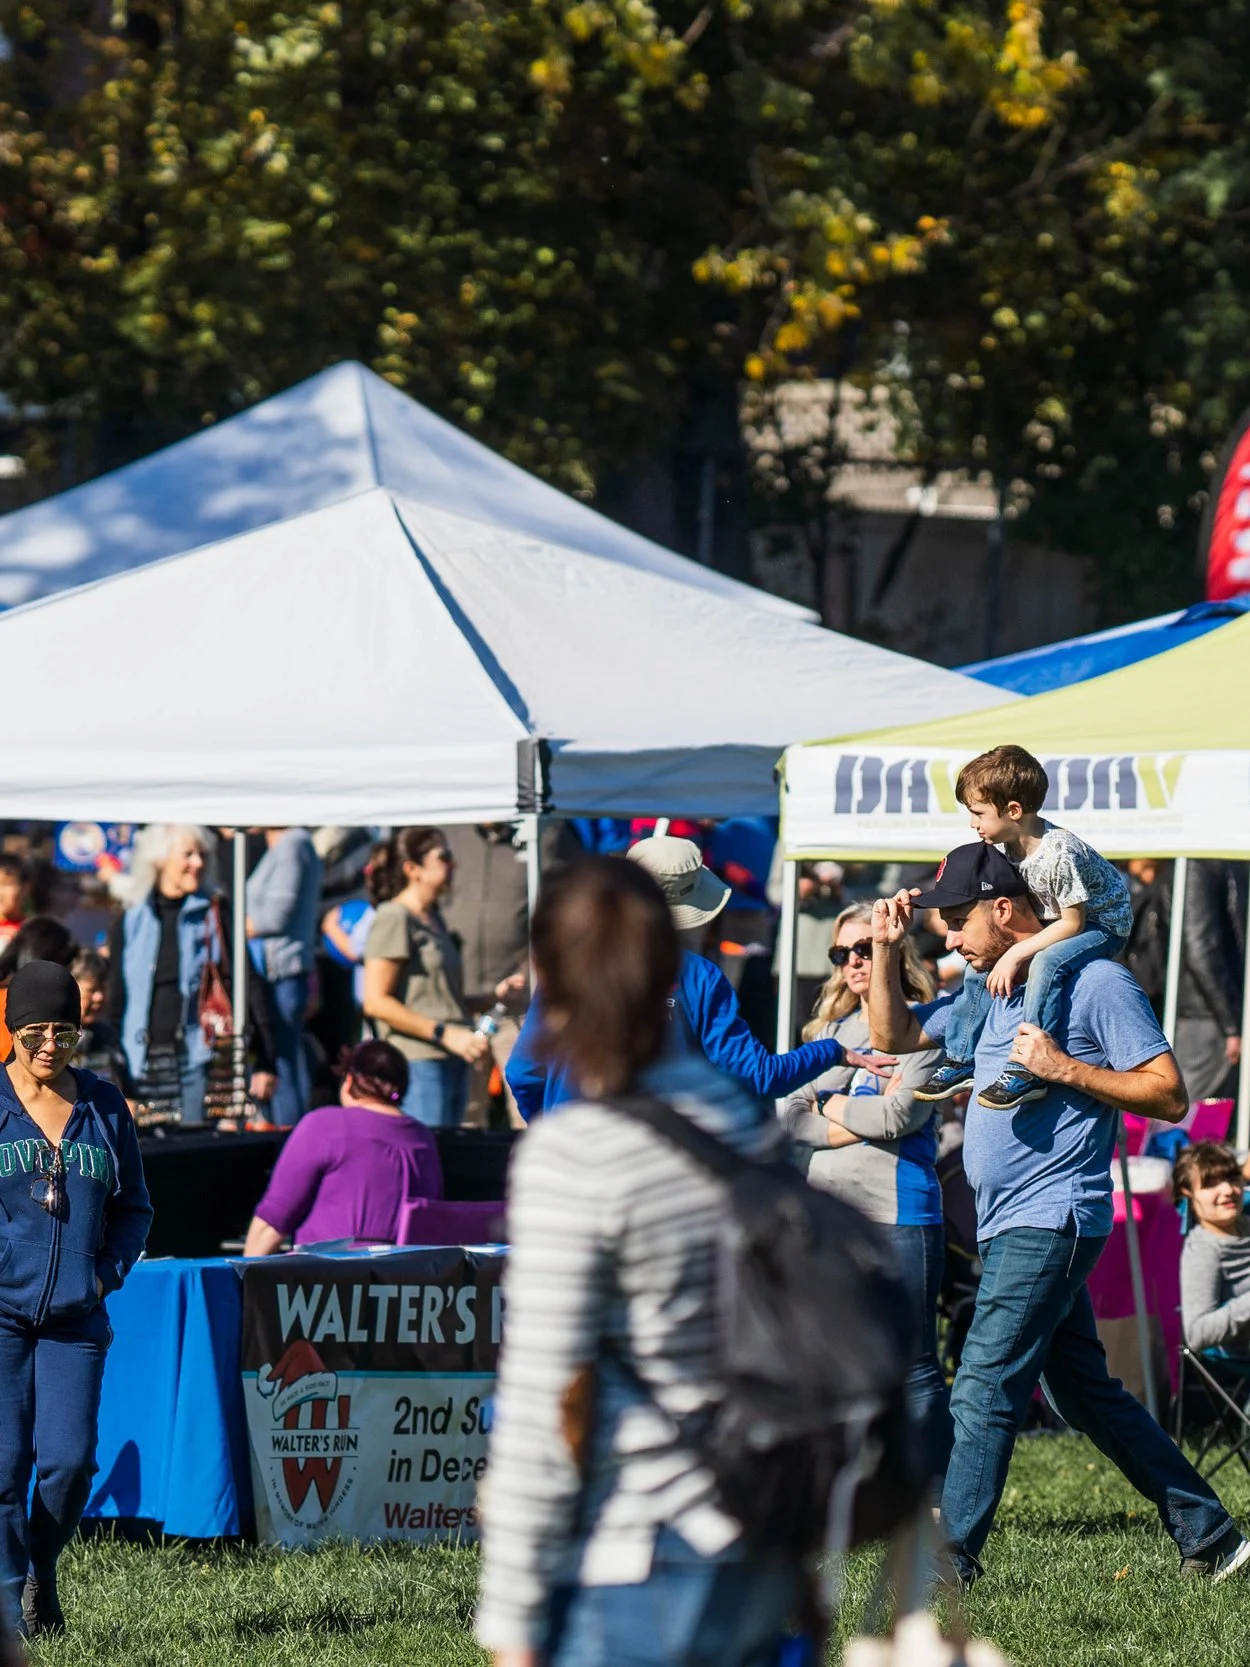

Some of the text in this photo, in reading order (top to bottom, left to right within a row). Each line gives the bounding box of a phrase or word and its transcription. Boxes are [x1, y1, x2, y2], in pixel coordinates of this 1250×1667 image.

[1042, 756, 1188, 811] DAV
[276, 1283, 477, 1344] WALTER'S
[393, 1396, 453, 1435] 2nd
[272, 1434, 358, 1452] WALTER'S RUN
[388, 1449, 412, 1482] in
